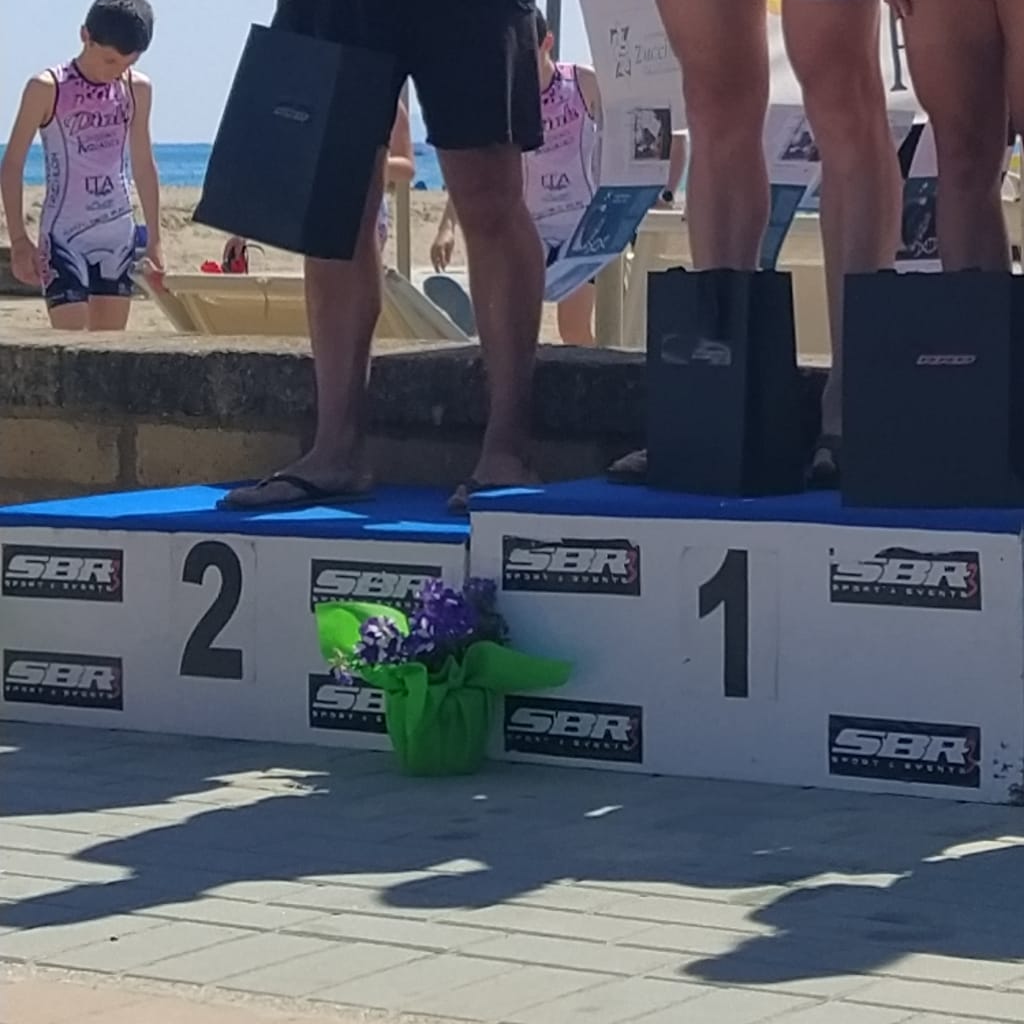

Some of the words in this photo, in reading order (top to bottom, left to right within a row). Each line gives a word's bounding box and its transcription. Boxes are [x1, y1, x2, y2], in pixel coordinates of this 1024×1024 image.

[84, 175, 115, 193] ITA
[180, 540, 243, 680] 2
[699, 548, 749, 698] 1
